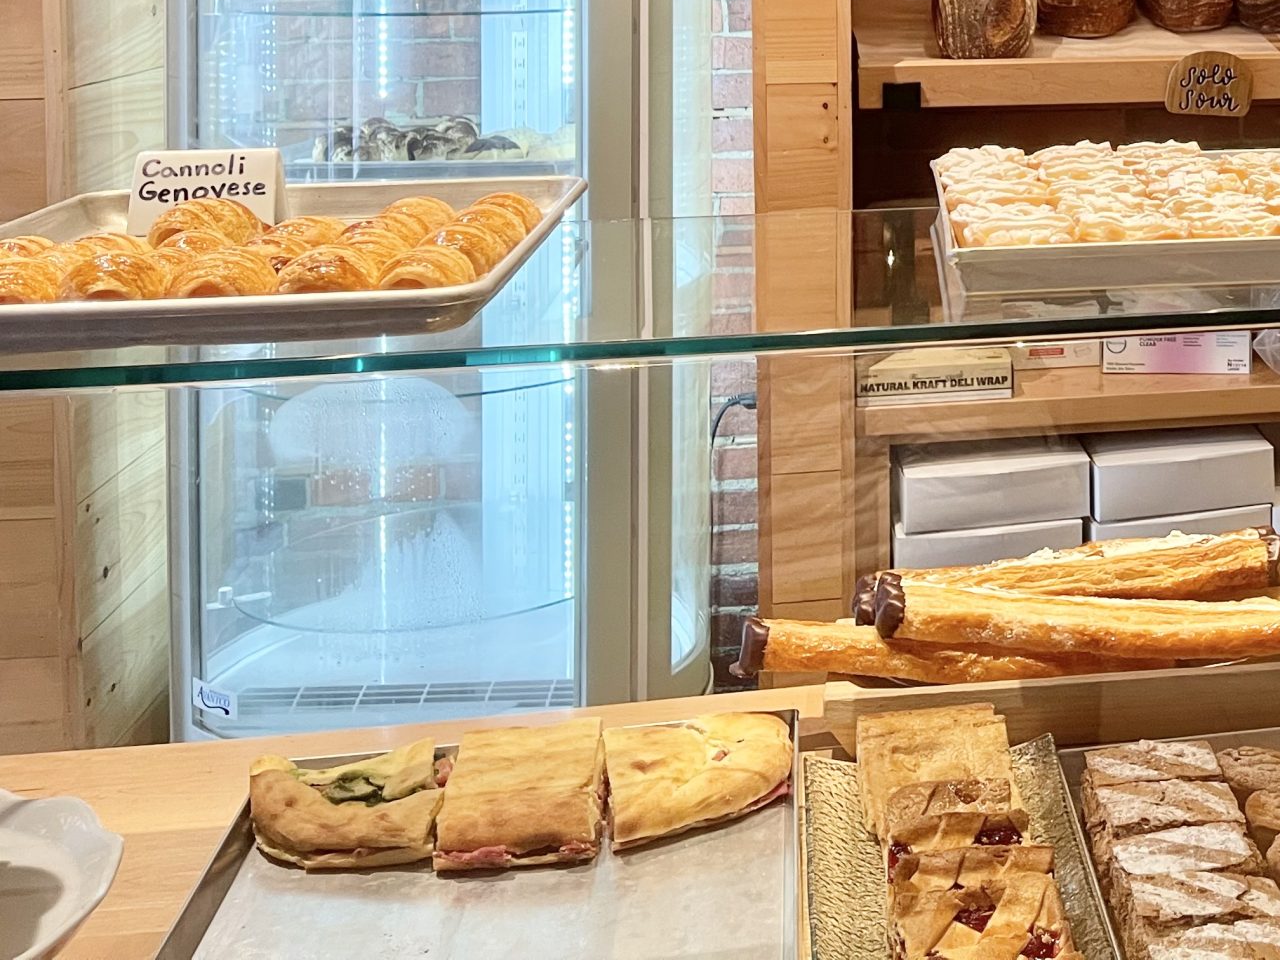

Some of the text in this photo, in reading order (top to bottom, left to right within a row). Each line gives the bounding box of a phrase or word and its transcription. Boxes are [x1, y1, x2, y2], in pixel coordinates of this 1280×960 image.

[1181, 64, 1237, 87] Solo
[1179, 90, 1239, 111] Sour
[142, 154, 245, 177] Cannoli
[138, 181, 266, 203] Genovese
[860, 382, 910, 393] NATURAL
[913, 378, 948, 390] KRAFT
[950, 377, 974, 388] DELI
[977, 375, 1008, 386] WRAP
